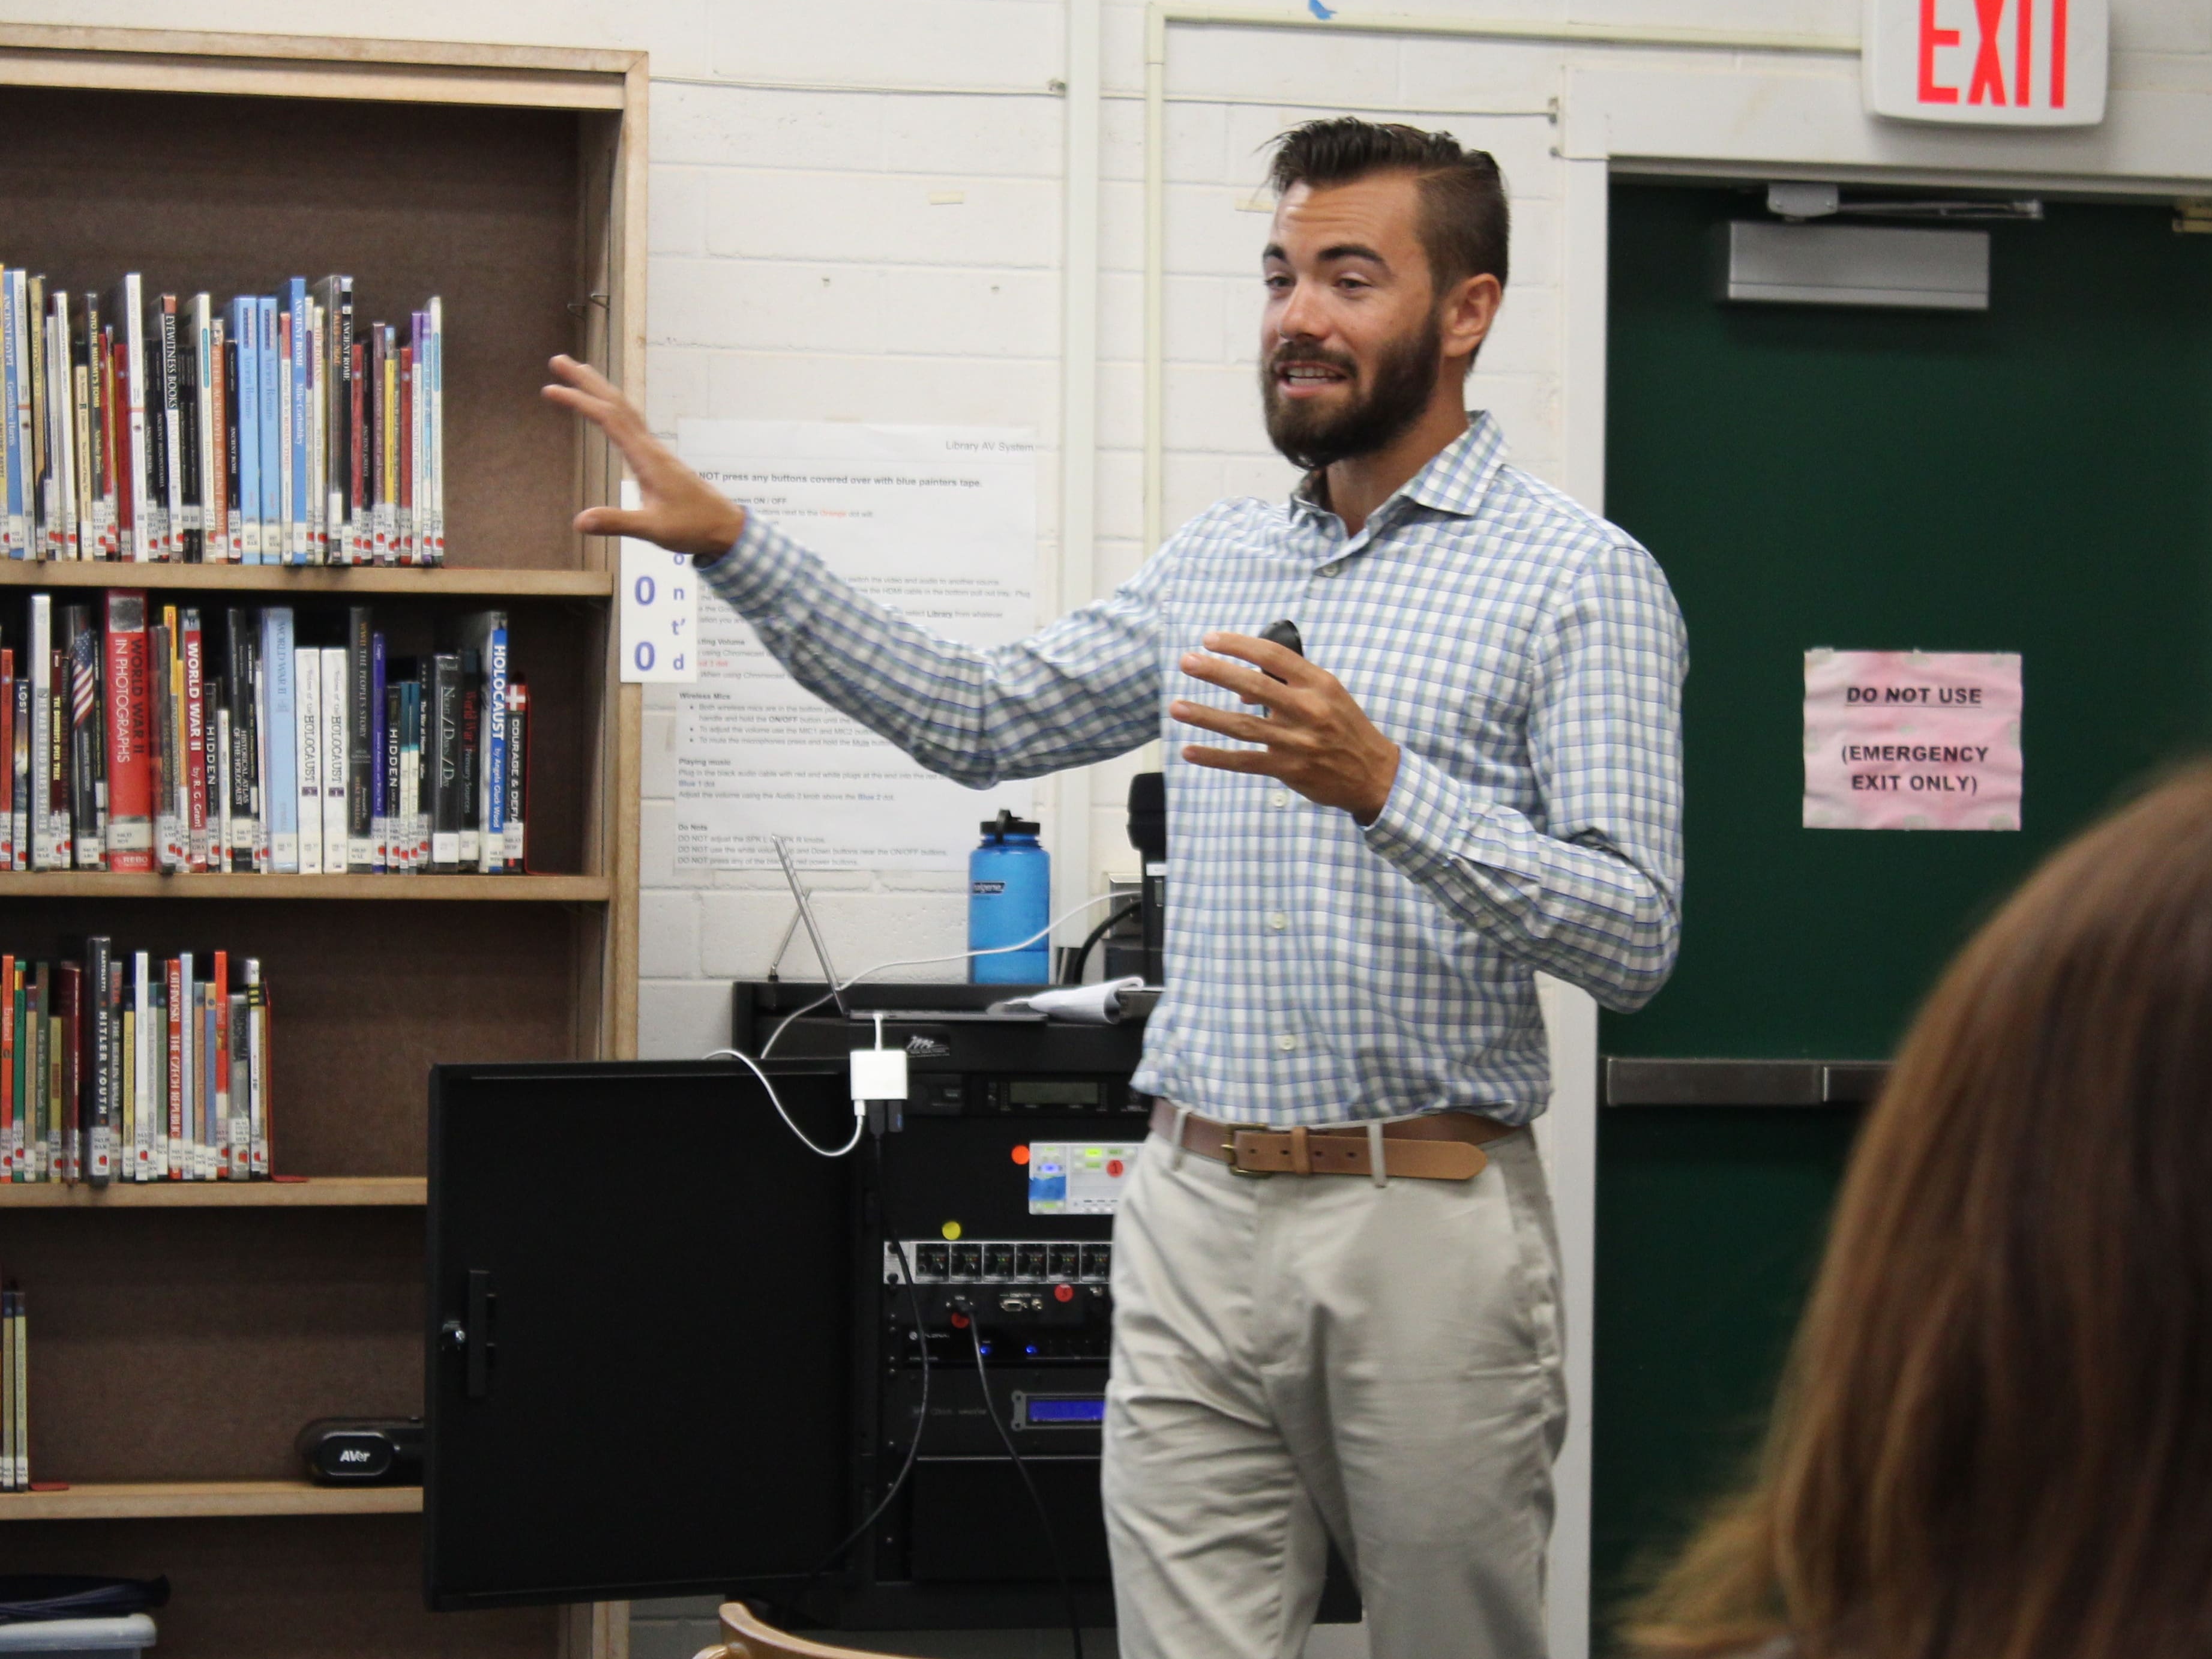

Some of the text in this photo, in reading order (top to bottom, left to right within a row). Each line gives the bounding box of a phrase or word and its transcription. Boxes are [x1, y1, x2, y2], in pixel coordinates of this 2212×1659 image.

[295, 299, 303, 339] ANCIENT
[166, 315, 176, 409] EYEWITNESS BOOKS
[212, 350, 220, 384] PETER
[7, 382, 16, 422] Geraldine
[946, 441, 1034, 453] Library AV System
[214, 448, 223, 496] ANCIENT
[699, 472, 721, 481] NOT
[723, 474, 750, 484] press
[771, 474, 808, 483] buttons
[810, 475, 847, 484] covered
[874, 477, 894, 485] with
[896, 477, 917, 486] blue
[919, 477, 957, 488] painters
[960, 480, 984, 489] tape.
[215, 499, 224, 529] ROME
[277, 621, 286, 661] WORLD
[277, 662, 286, 685] WAR
[115, 639, 130, 763] IN PHOTOGRAPHS
[133, 639, 144, 753] WORLD WAR II
[187, 642, 202, 751] WORLD WAR II
[491, 645, 506, 741] HOLOCAUST
[1847, 687, 1982, 703] DO NOT USE
[38, 711, 47, 730] WAR
[233, 727, 241, 737] OF
[38, 746, 47, 763] END
[206, 725, 215, 786] HIDDEN
[304, 715, 315, 783] HOLOCAUST
[331, 715, 342, 783] HOLOCAUST
[388, 727, 398, 788] HIDDEN
[463, 750, 472, 780] Primary
[493, 748, 500, 757] by
[1841, 744, 1989, 765] (EMERGENCY
[38, 766, 48, 790] WARS
[234, 758, 242, 805] HOLOCAUST
[493, 758, 502, 784] Angela
[511, 717, 520, 823] COURAGE & DEFIA
[1851, 774, 1978, 795] EXIT ONLY)
[191, 767, 202, 828] by R. G. Grant
[464, 782, 472, 814] Sources
[493, 807, 502, 828] Wood
[98, 1010, 108, 1115] HITLER YOUTH
[112, 1082, 121, 1109] WALL
[170, 1035, 181, 1137] THE CZECH REPUBLIC
[340, 1449, 371, 1463] AVer
